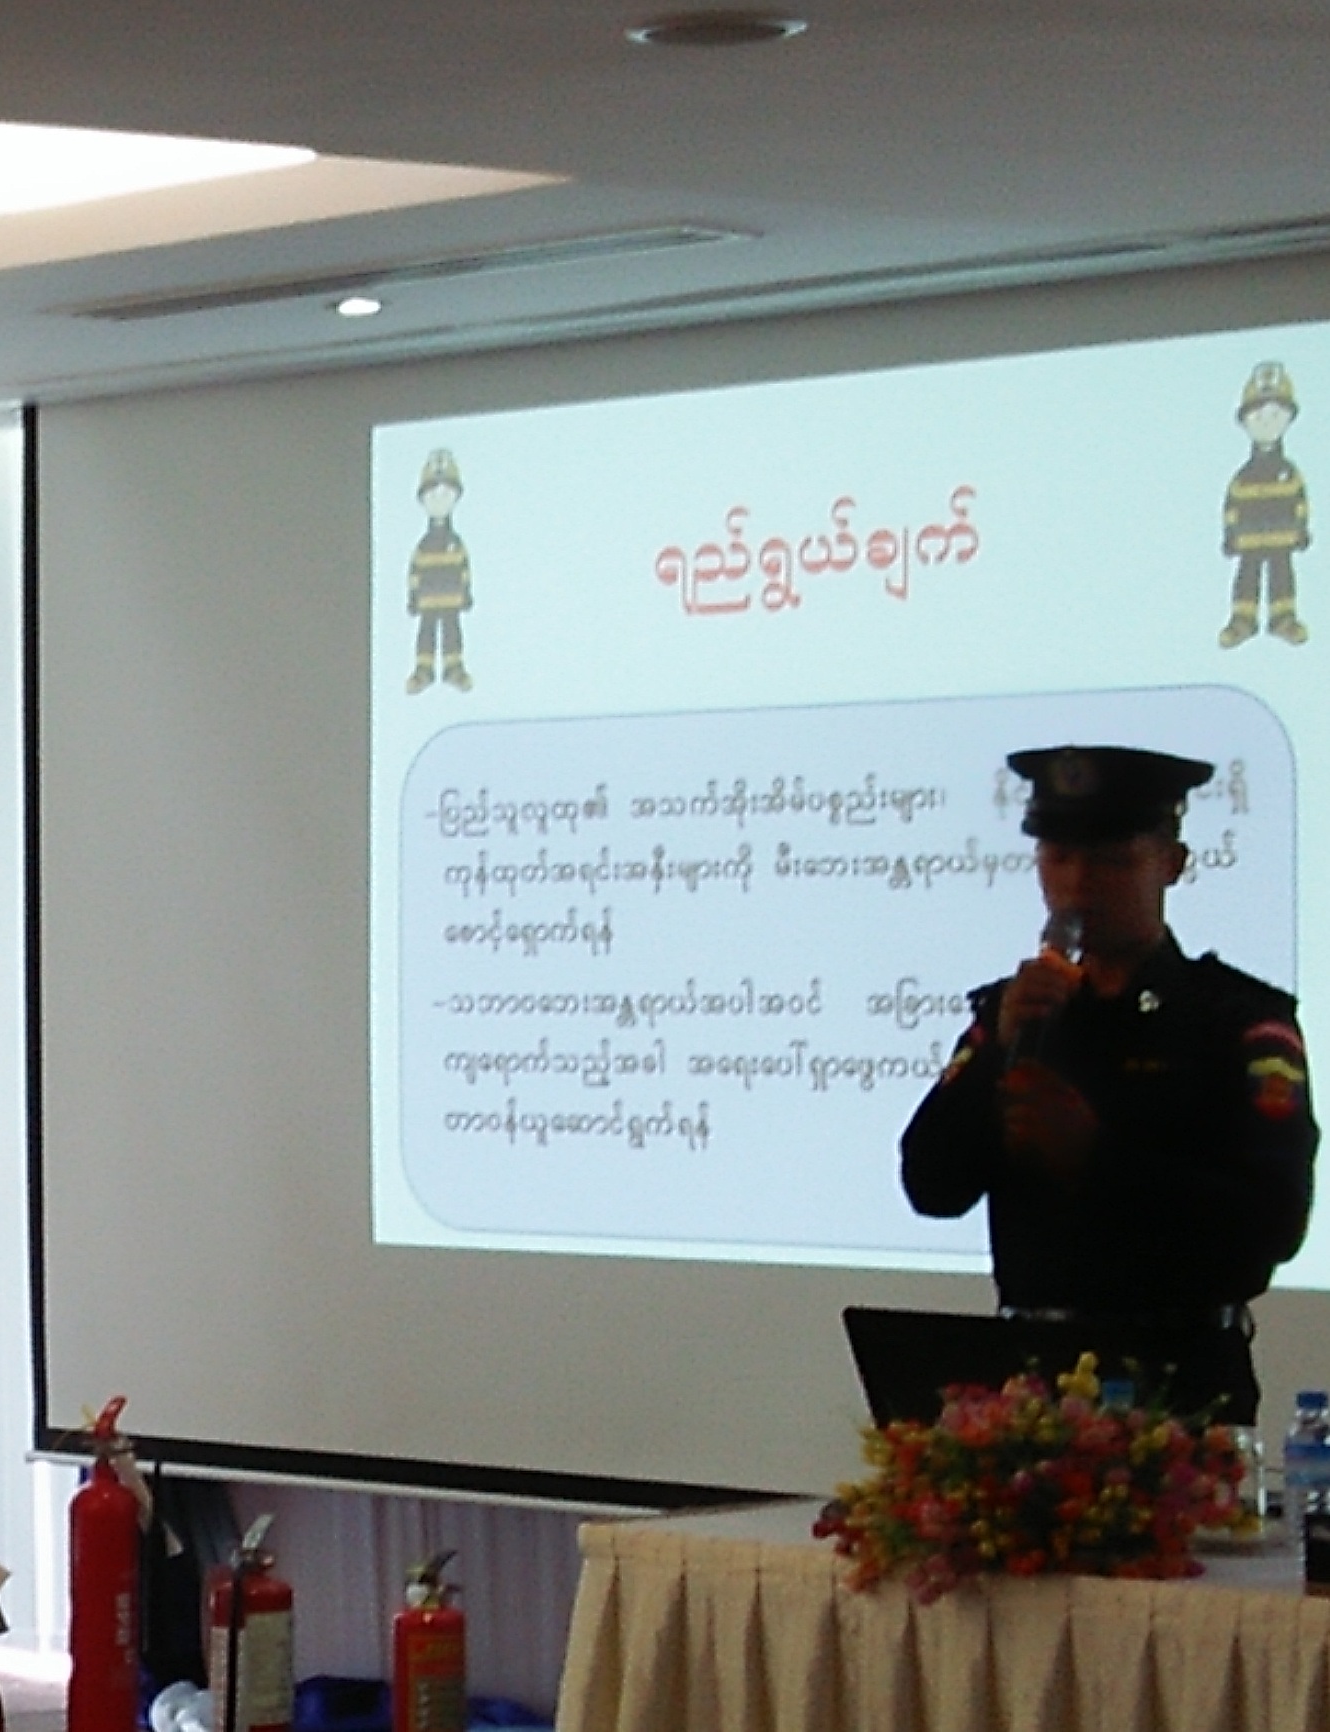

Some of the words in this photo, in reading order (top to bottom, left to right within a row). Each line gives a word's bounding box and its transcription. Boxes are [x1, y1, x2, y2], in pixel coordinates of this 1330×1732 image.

[655, 484, 979, 614] ရည်ရွယ်ချက်
[444, 905, 613, 957] စောင့်ရှောက်ရန်
